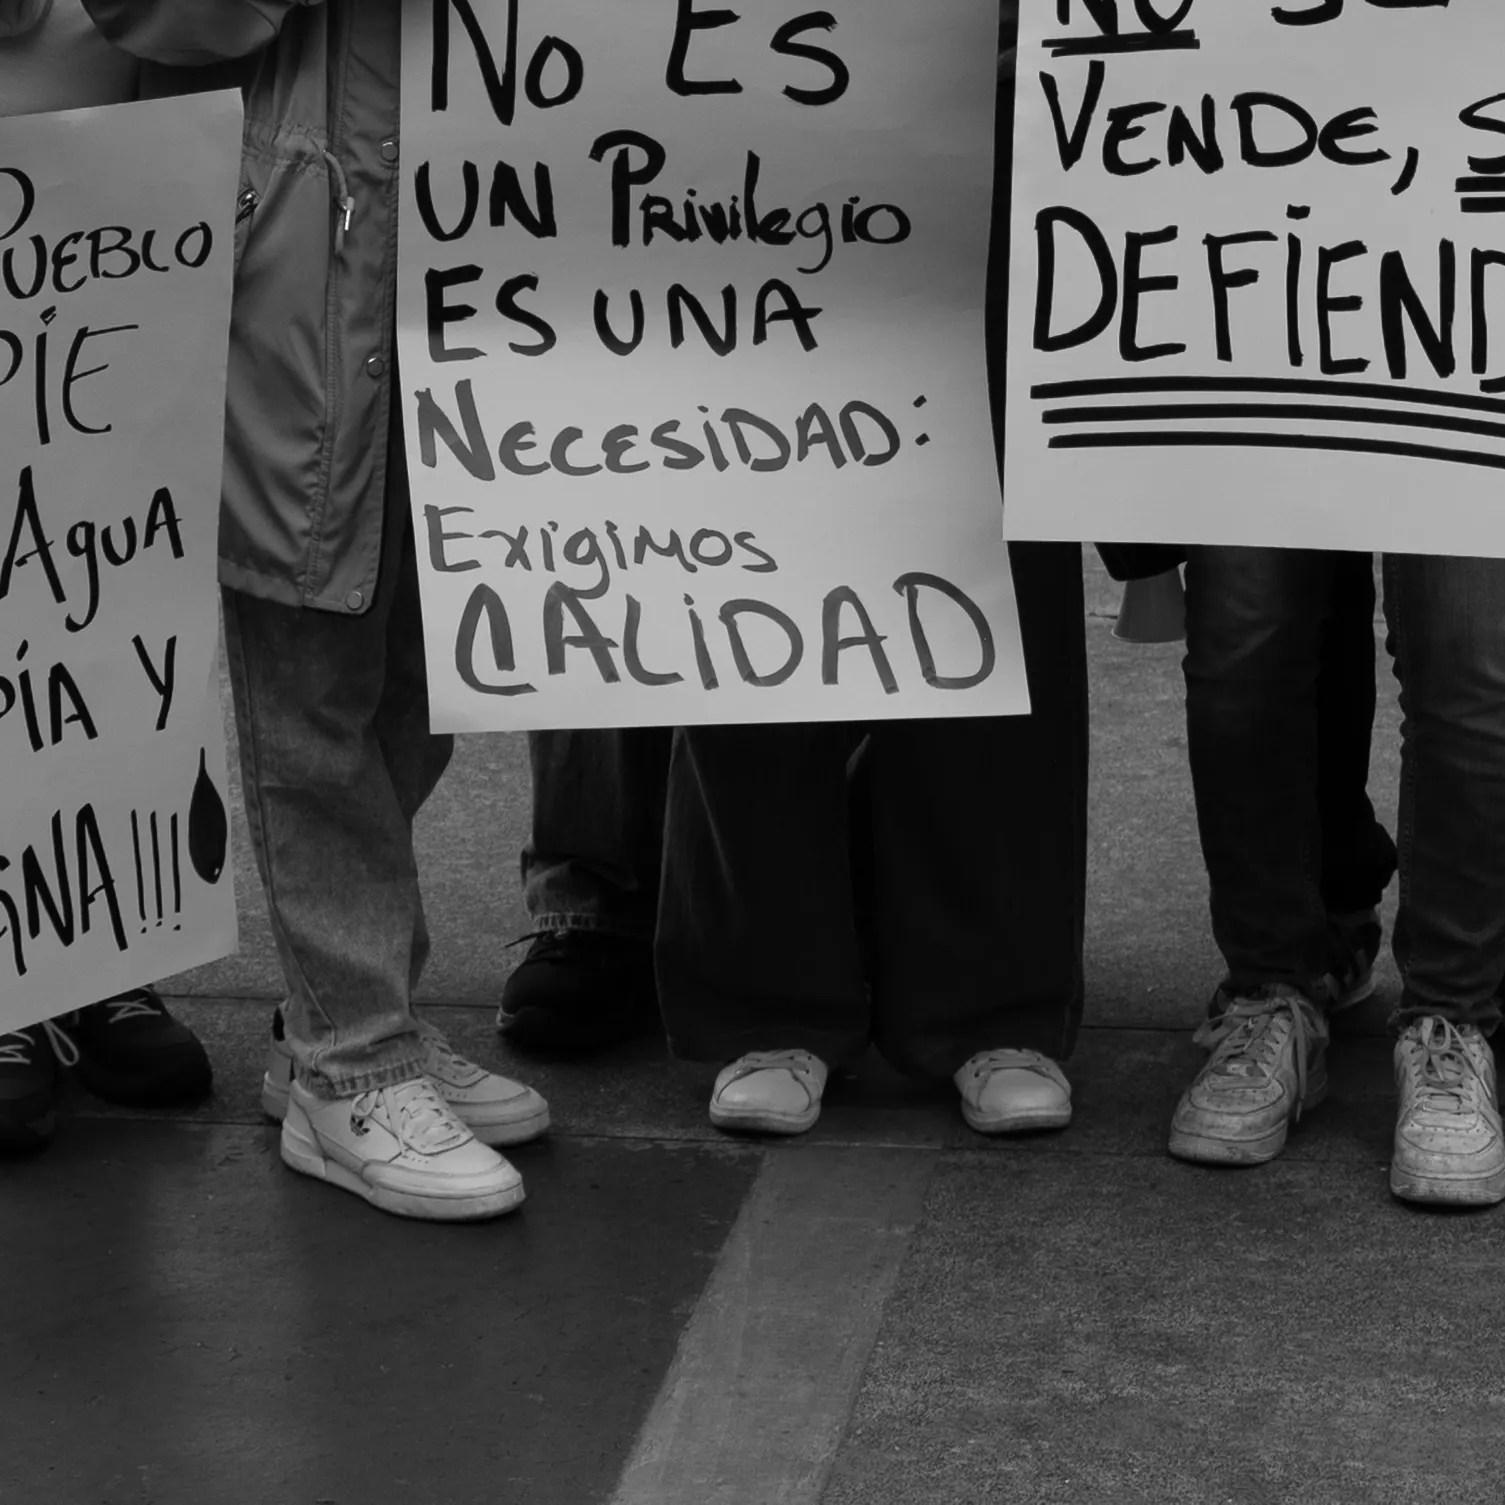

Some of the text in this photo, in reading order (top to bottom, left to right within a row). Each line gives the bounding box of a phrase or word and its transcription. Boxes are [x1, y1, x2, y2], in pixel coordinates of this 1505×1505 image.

[1040, 60, 1418, 195] VENDE,
[415, 161, 557, 241] UN
[425, 264, 823, 362] ES UNA
[132, 635, 176, 730] Y
